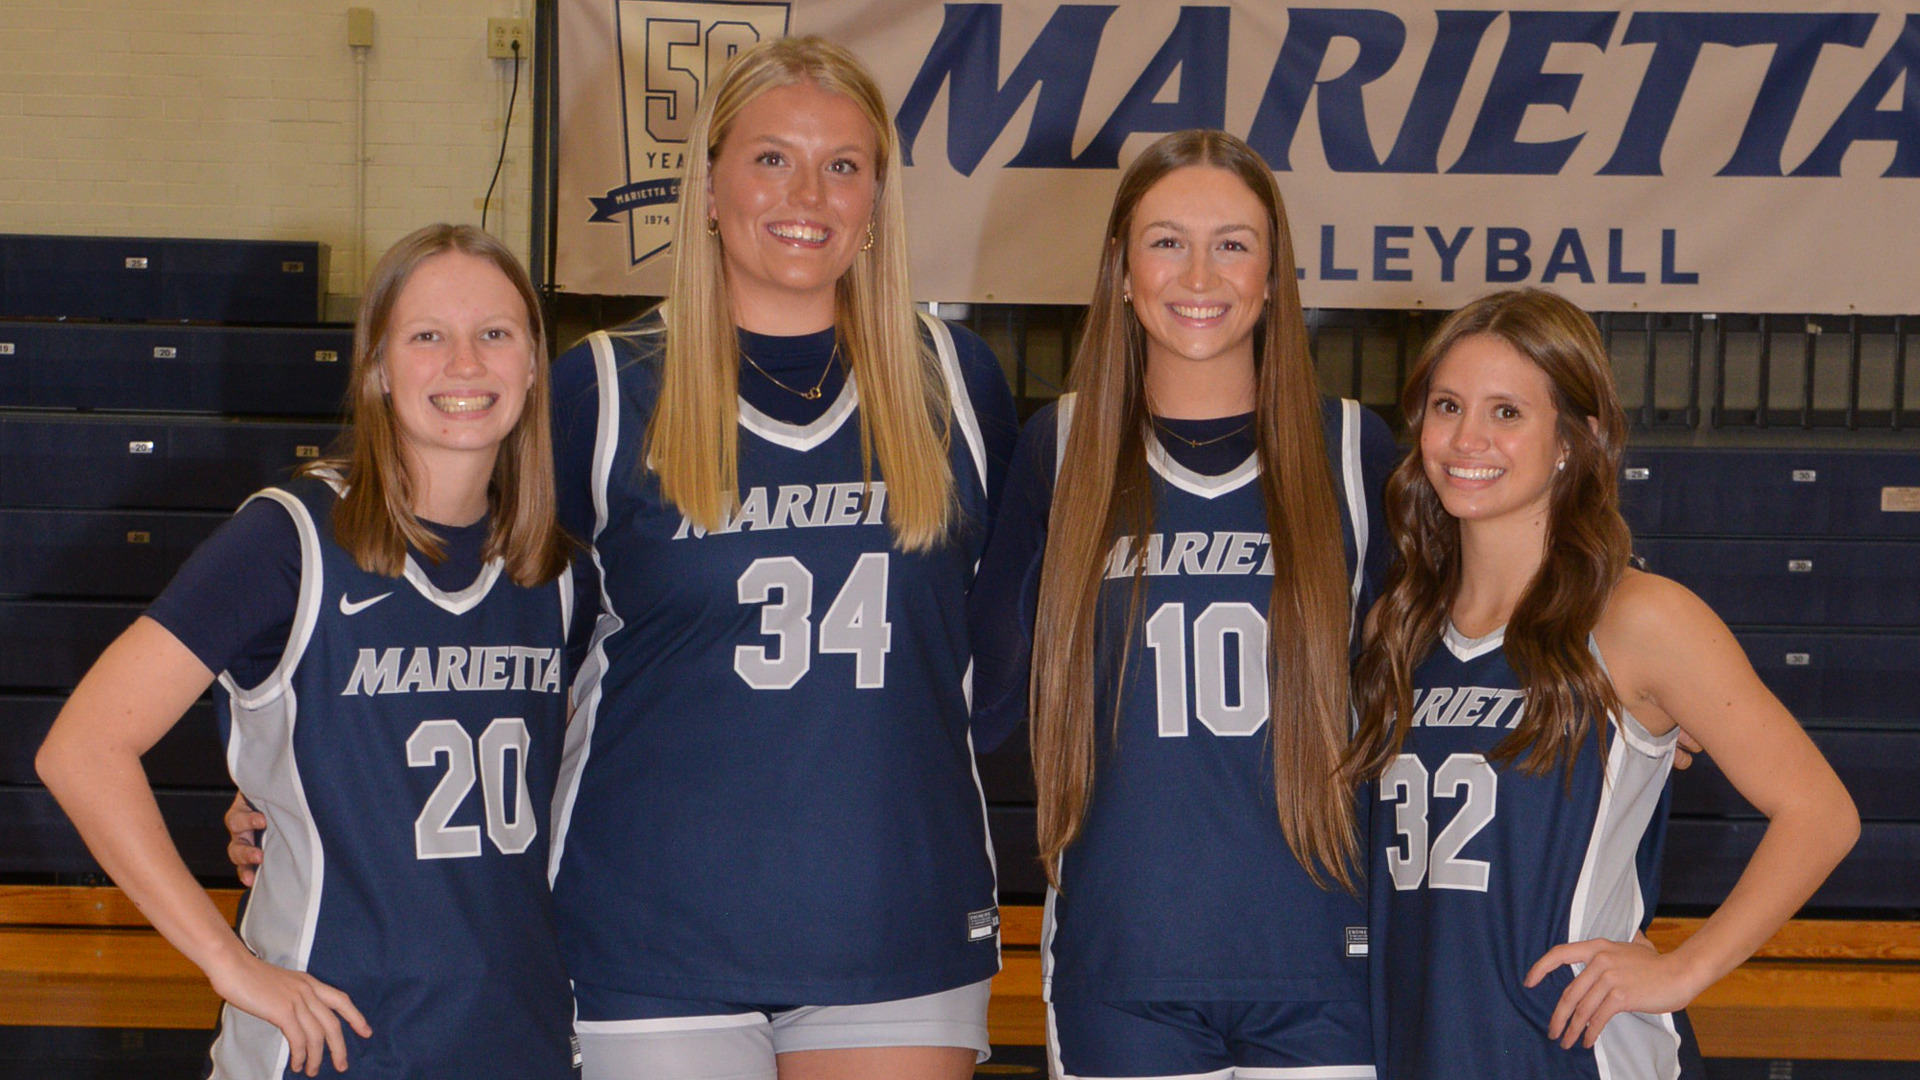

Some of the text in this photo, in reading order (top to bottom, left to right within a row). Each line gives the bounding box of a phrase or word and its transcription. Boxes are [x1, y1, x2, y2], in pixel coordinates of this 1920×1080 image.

[895, 3, 1920, 178] MARIETTA
[615, 187, 666, 205] MARIETTA
[1296, 224, 1699, 284] LEYBALL
[160, 349, 171, 357] 20
[135, 443, 147, 452] 20
[734, 552, 892, 690] 34
[1146, 602, 1270, 738] 10
[341, 646, 561, 697] MARIETTA
[406, 717, 537, 860] 20
[1380, 753, 1498, 893] 32
